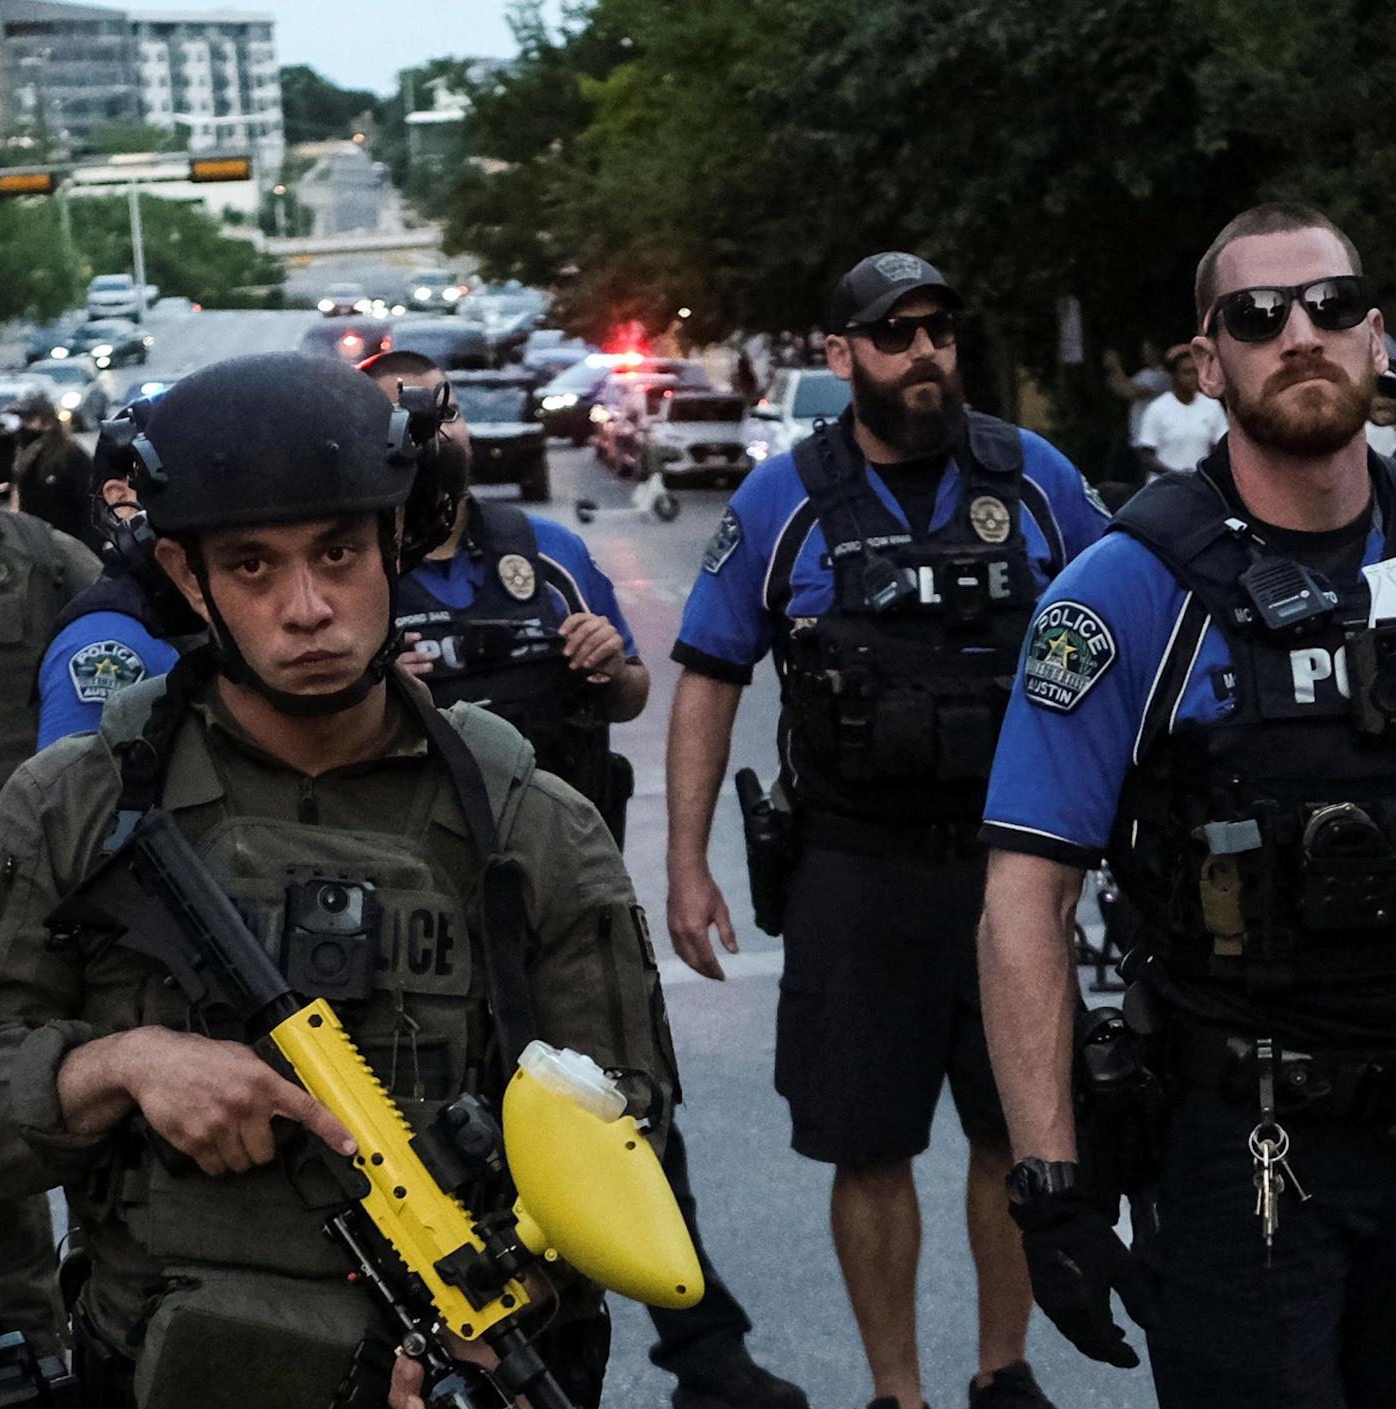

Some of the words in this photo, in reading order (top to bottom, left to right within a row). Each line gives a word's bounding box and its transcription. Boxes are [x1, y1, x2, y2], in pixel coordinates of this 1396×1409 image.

[1037, 607, 1109, 656] POLICE
[76, 645, 141, 670] POLICE
[84, 686, 108, 697] AUS
